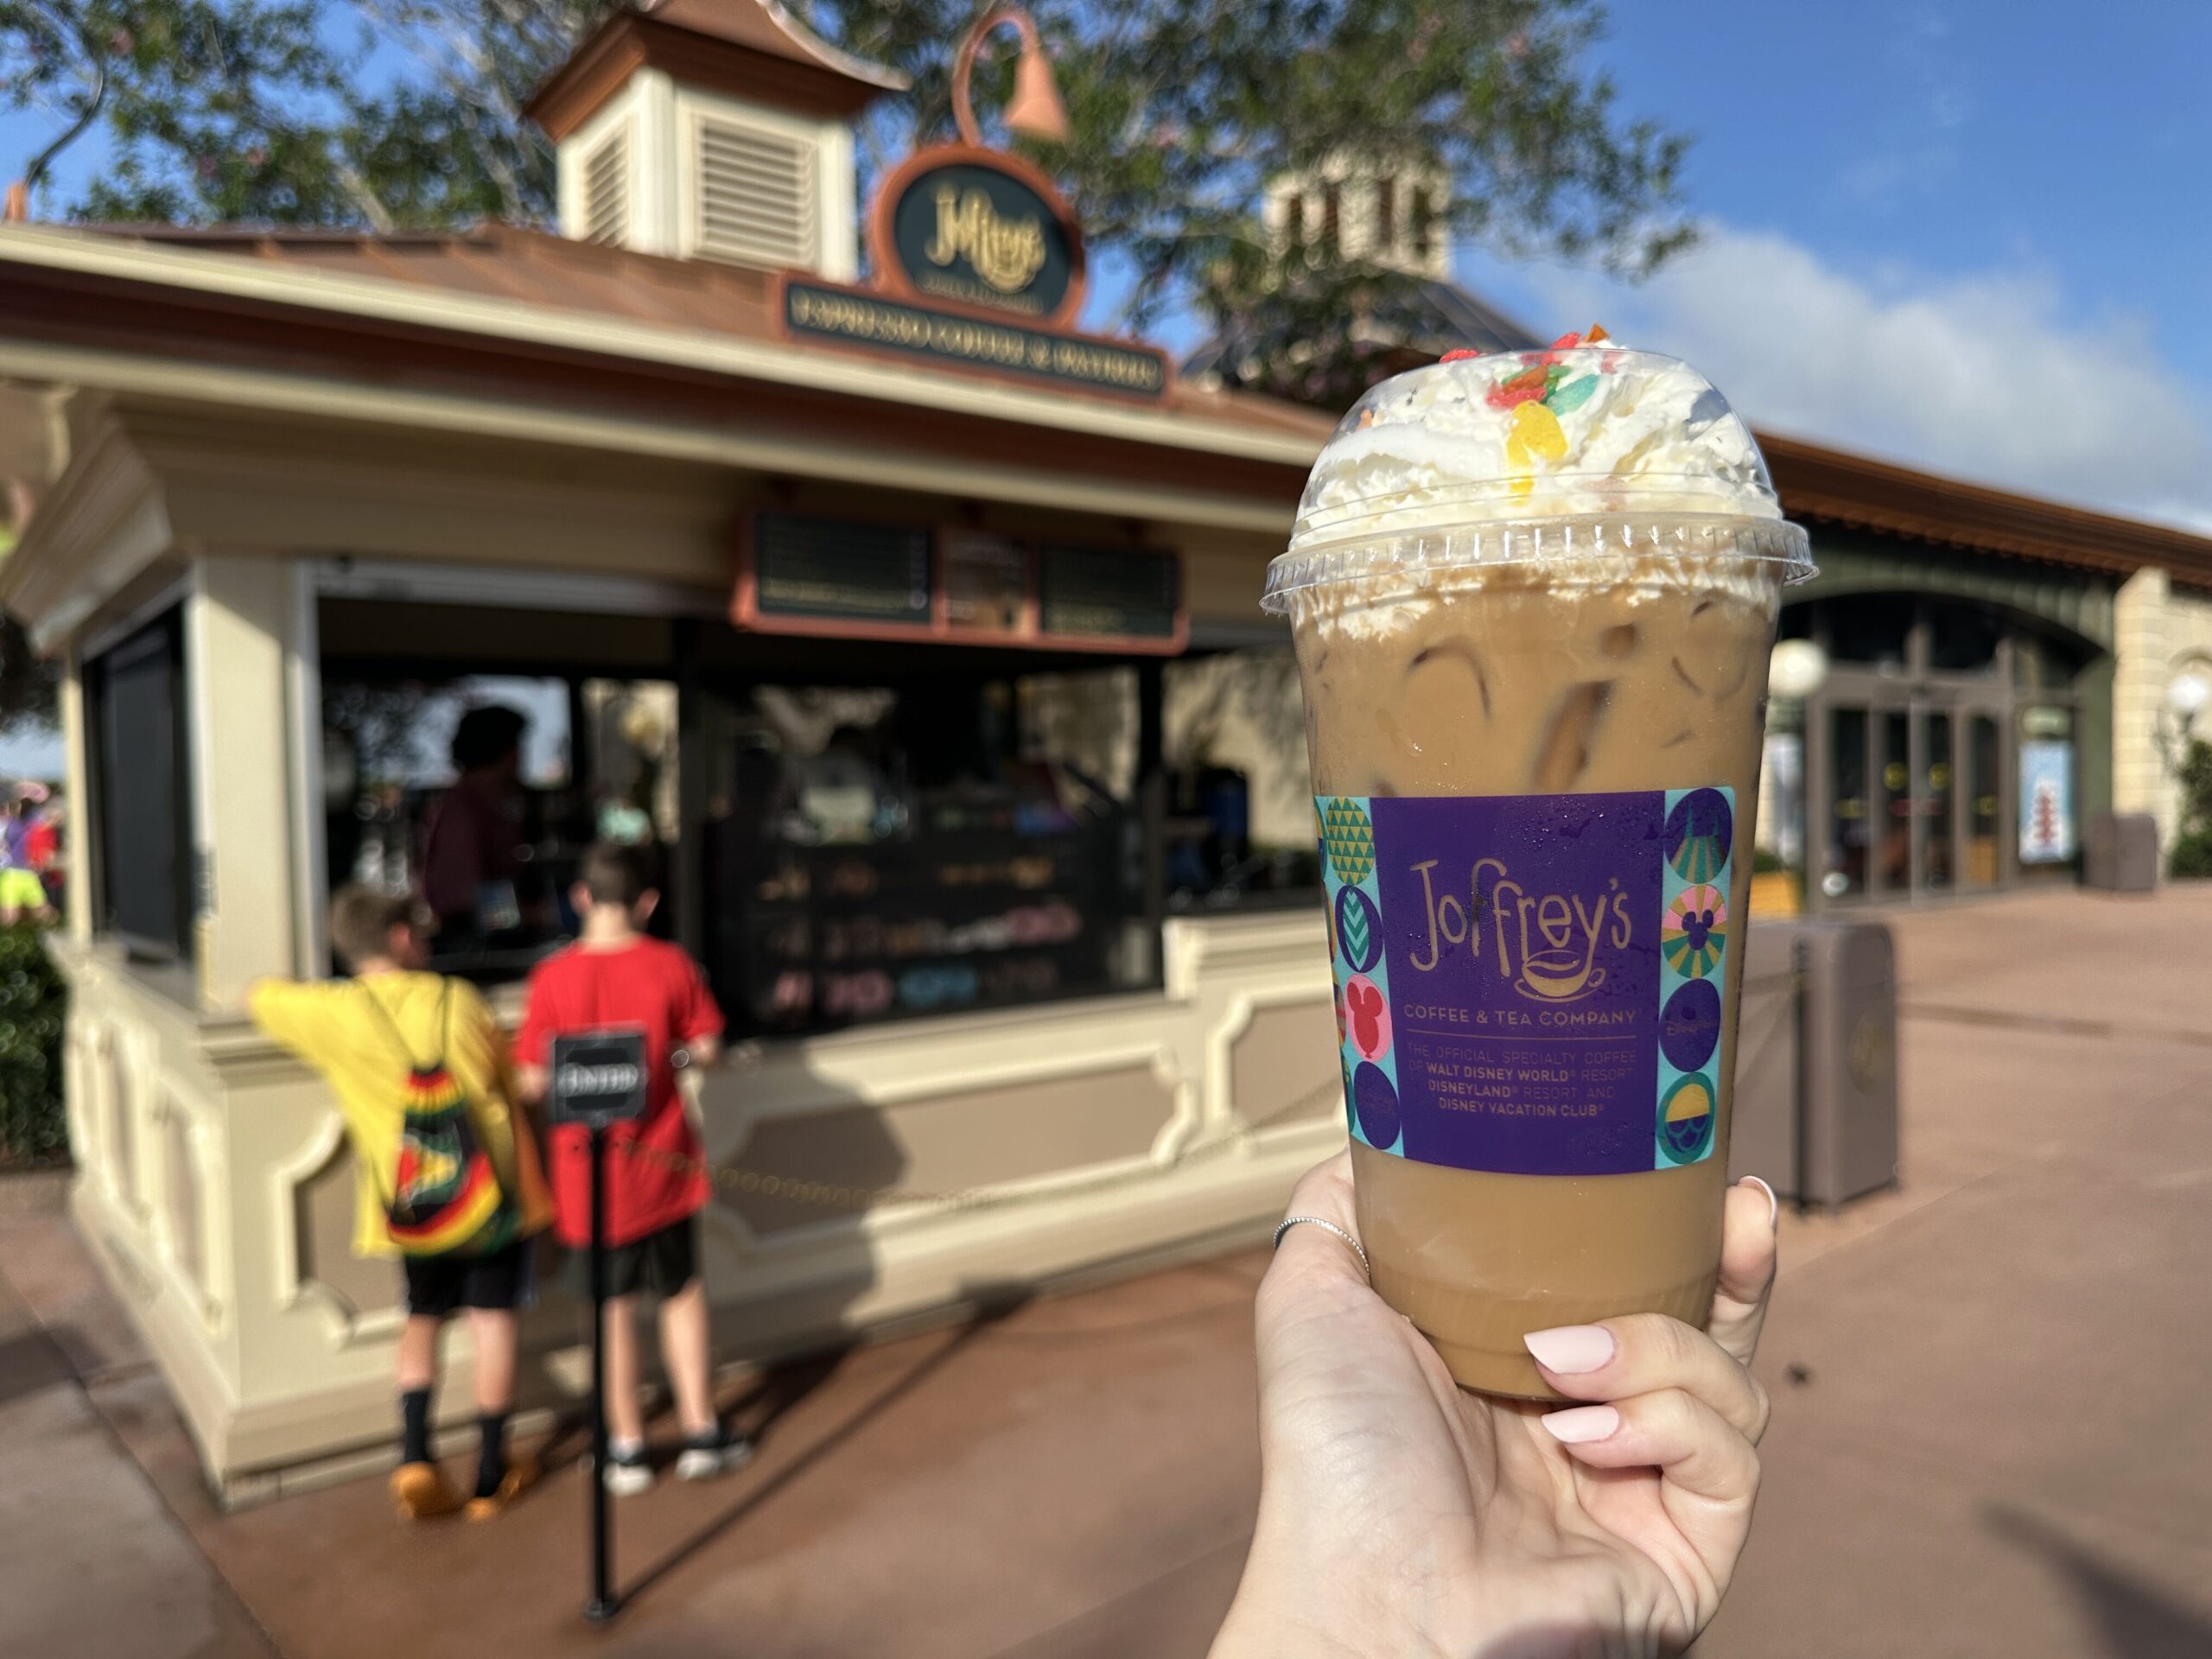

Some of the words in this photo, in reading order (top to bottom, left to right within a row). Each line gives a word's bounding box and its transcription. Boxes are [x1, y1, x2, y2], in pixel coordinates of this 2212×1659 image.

[1410, 857, 1631, 995] Joffrey's
[1403, 1004, 1470, 1023] COFFEE
[1476, 1010, 1488, 1024] &
[1494, 1010, 1532, 1027] TEA
[1539, 1008, 1637, 1027] COMPANY
[1407, 1043, 1430, 1058] THE
[1435, 1046, 1495, 1063] OFFICIAL
[1502, 1051, 1577, 1065] SPECIALTY
[1584, 1049, 1637, 1064] COFFEE
[1408, 1059, 1425, 1072] OF
[1426, 1061, 1460, 1077] WALT
[1463, 1065, 1514, 1081] DISNEY
[1522, 1086, 1578, 1100] RESORT
[1586, 1085, 1617, 1099] AND
[1438, 1096, 1485, 1113] DISNEY
[1489, 1103, 1556, 1116] VACATION
